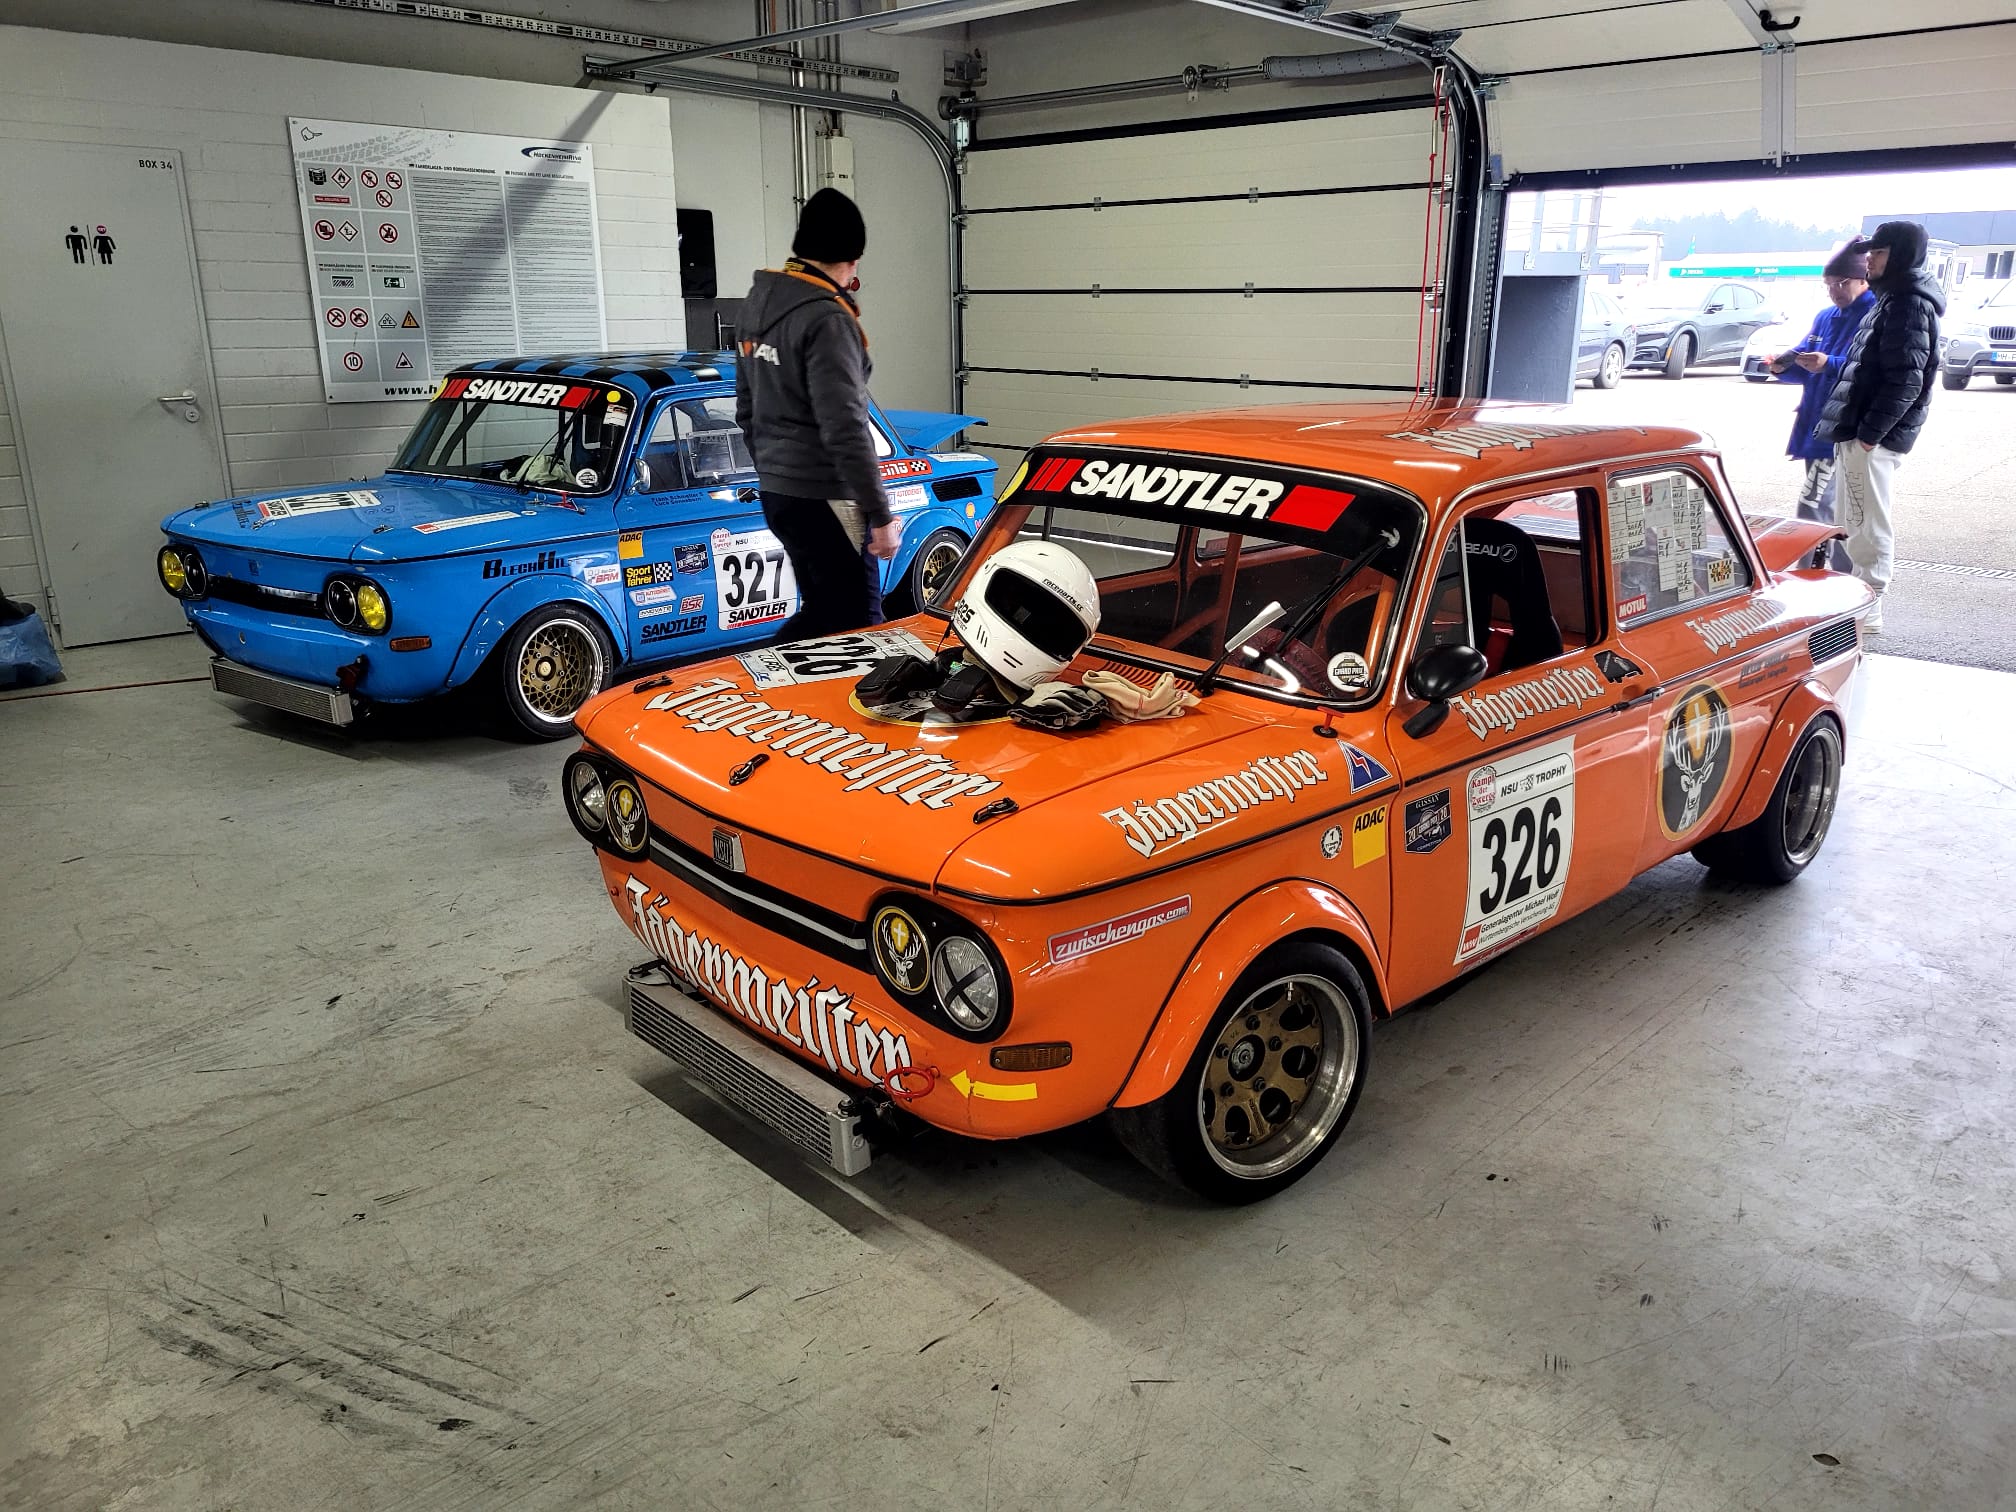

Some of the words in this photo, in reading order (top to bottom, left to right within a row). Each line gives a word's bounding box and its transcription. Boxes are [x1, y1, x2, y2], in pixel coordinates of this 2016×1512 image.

[139, 159, 158, 169] BOX
[160, 161, 173, 170] 34
[347, 356, 359, 368] 10
[463, 378, 567, 406] SANDTLER
[1070, 461, 1285, 520] SANDTLER
[620, 532, 642, 543] ADAC
[735, 538, 749, 546] NSU
[595, 572, 619, 583] BRM
[626, 565, 651, 578] Sport
[627, 575, 653, 587] fahrer
[723, 549, 785, 607] 327
[681, 599, 702, 610] BSK
[727, 602, 788, 623] SANDTLER
[1619, 598, 1647, 618] MOTUL
[641, 615, 708, 638] SANDTLER
[1449, 665, 1606, 740] Jägermeister
[644, 677, 1004, 809] Jägermeister
[1471, 774, 1496, 789] Kampf
[1478, 786, 1488, 795] der
[1500, 782, 1519, 797] NSU
[1535, 764, 1567, 784] TROPHY
[1100, 749, 1328, 858] Jägermeister
[1471, 791, 1497, 806] Zwerge
[1354, 806, 1386, 834] ADAC
[715, 839, 733, 864] NSU
[1479, 796, 1563, 915] 326
[1481, 907, 1523, 933] Generalagentur
[1524, 895, 1547, 913] Michael
[1054, 904, 1189, 958] zwischengas.com
[625, 873, 913, 1094] Jägermeister
